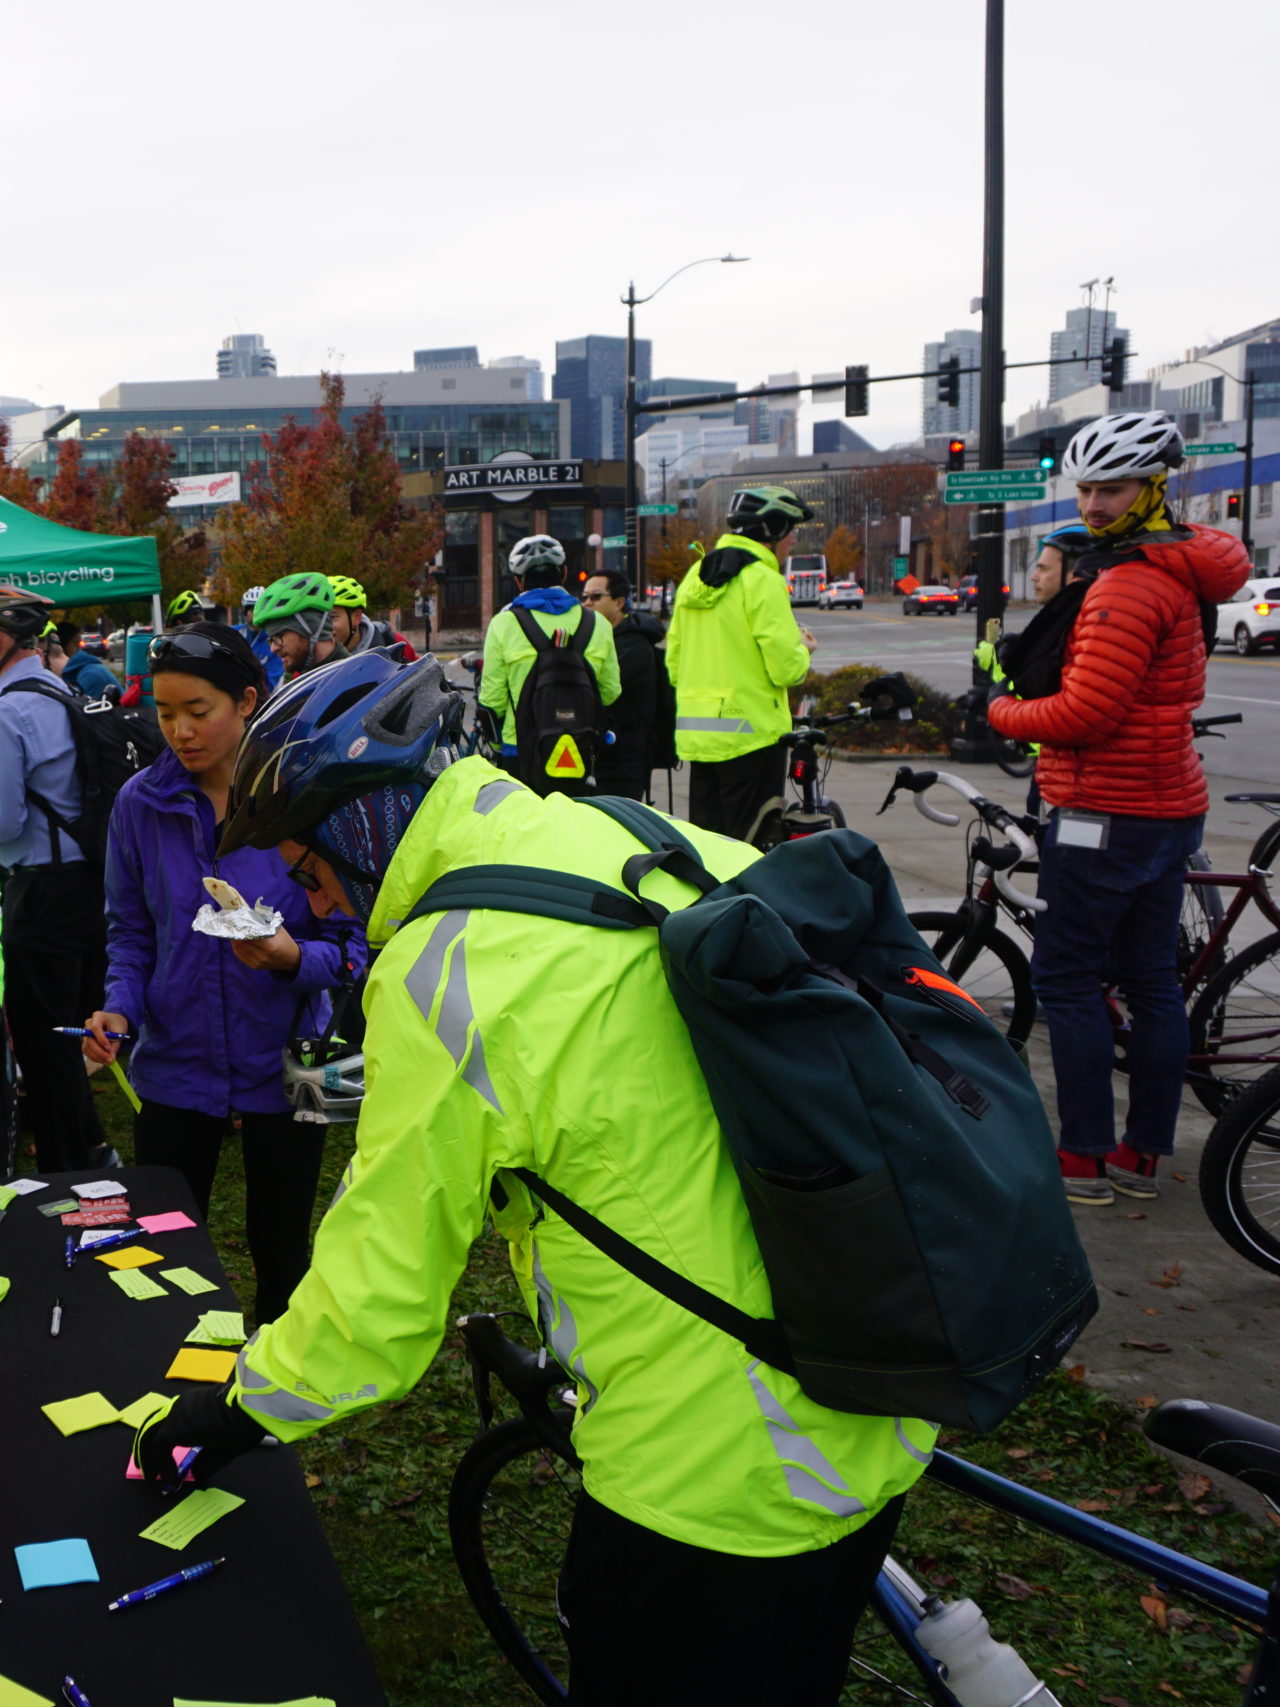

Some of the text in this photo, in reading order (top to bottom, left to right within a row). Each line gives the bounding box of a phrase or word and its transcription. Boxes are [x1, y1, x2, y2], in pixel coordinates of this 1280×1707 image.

[447, 466, 579, 487] ART MARBLE 21
[959, 475, 987, 483] Downtown
[1021, 489, 1039, 497] Union
[28, 566, 115, 586] bicycling
[350, 739, 367, 757] BELL
[295, 1381, 371, 1405] EURA
